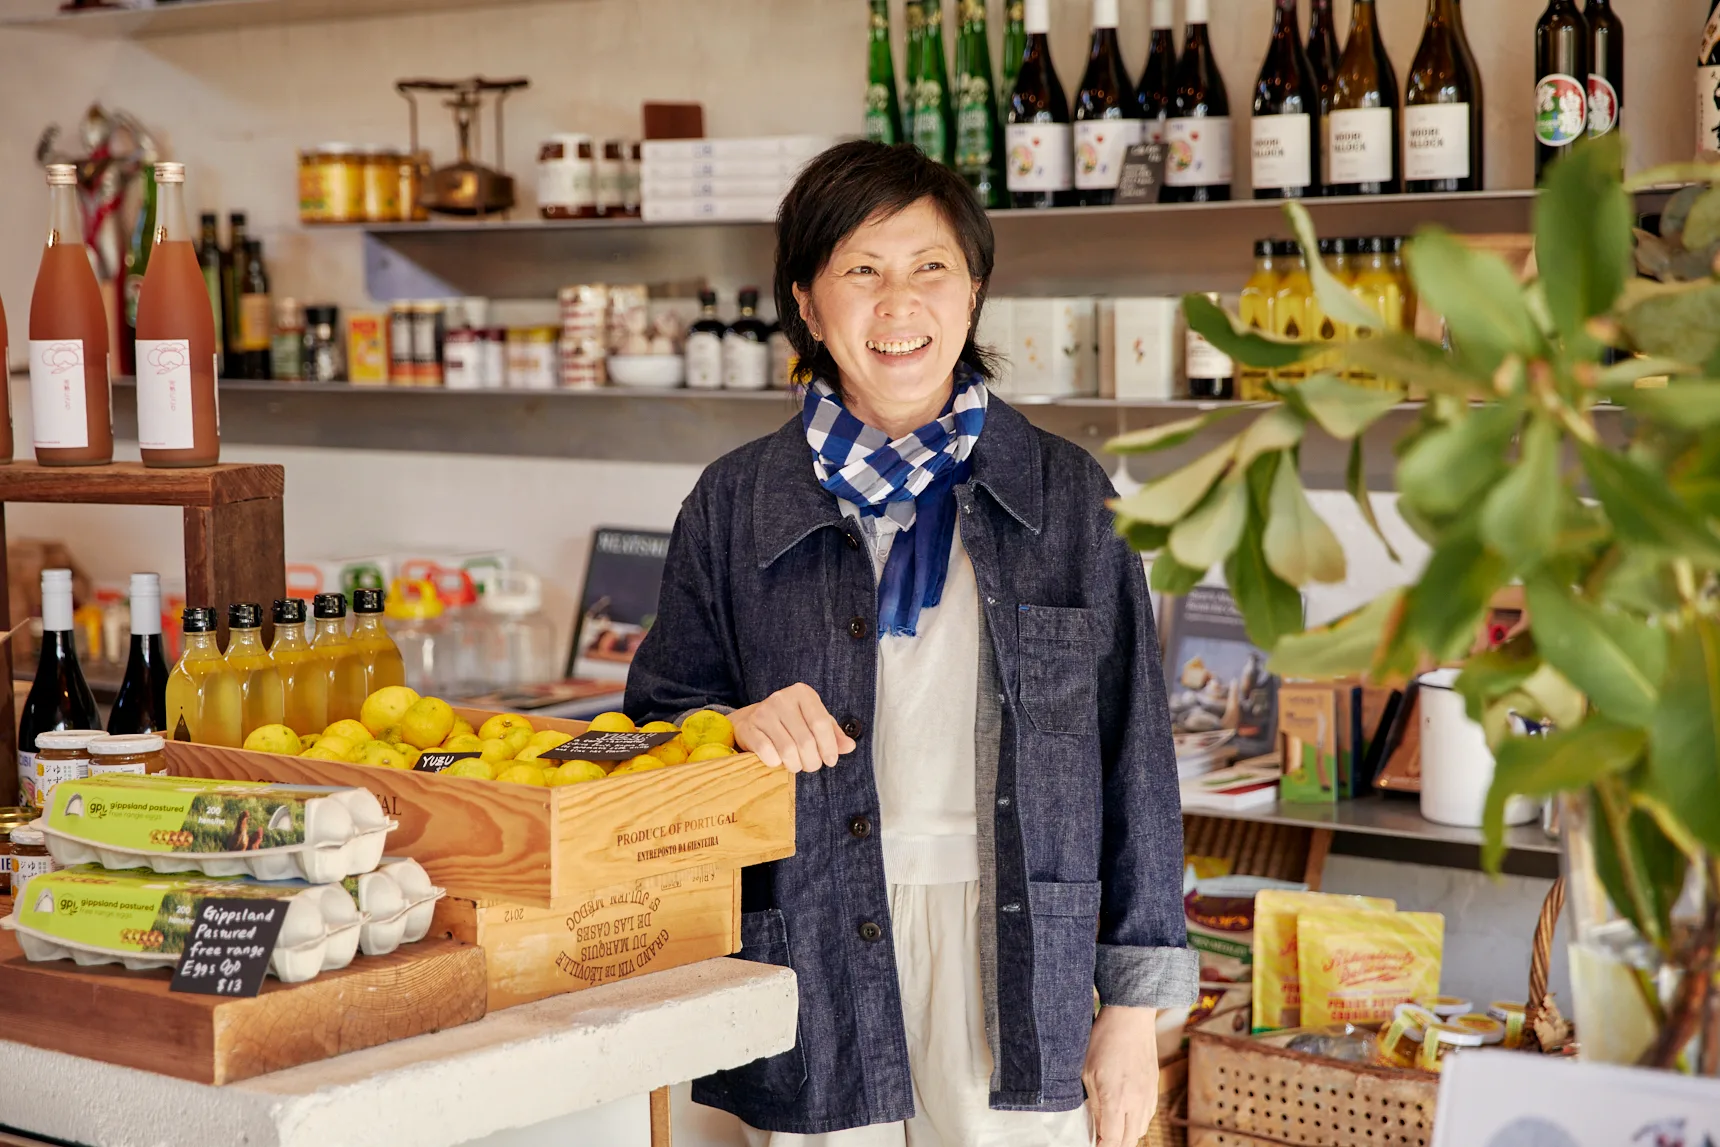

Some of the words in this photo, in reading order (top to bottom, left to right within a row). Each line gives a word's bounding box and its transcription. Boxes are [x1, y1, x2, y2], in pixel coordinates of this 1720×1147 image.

[423, 755, 454, 768] YUZU
[110, 801, 147, 811] gippsland
[149, 803, 184, 813] pastured
[206, 806, 221, 815] 200
[617, 826, 666, 846] PRODUCE
[668, 822, 682, 835] OF
[684, 812, 738, 833] PORTUGAL
[637, 844, 677, 862] ENTREPOSTO
[678, 842, 687, 853] DA
[687, 836, 719, 850] GIESTEIRA
[80, 898, 118, 908] gippsland
[120, 901, 154, 912] pastured
[176, 905, 191, 914] 200
[203, 905, 275, 925] Gippsland
[504, 908, 524, 922] 2012
[566, 896, 605, 932] MÉDOC
[637, 912, 652, 929] DE
[195, 923, 257, 940] Pastured
[576, 921, 611, 942] CASES
[614, 916, 634, 934] LAS
[190, 941, 221, 957] free
[227, 945, 265, 958] range
[581, 937, 629, 963] MARQUIS
[632, 933, 647, 950] DU
[636, 929, 670, 968] GRAND
[181, 960, 216, 978] Eggs
[605, 966, 616, 978] DE
[618, 959, 636, 978] VIN
[217, 979, 242, 993] $13
